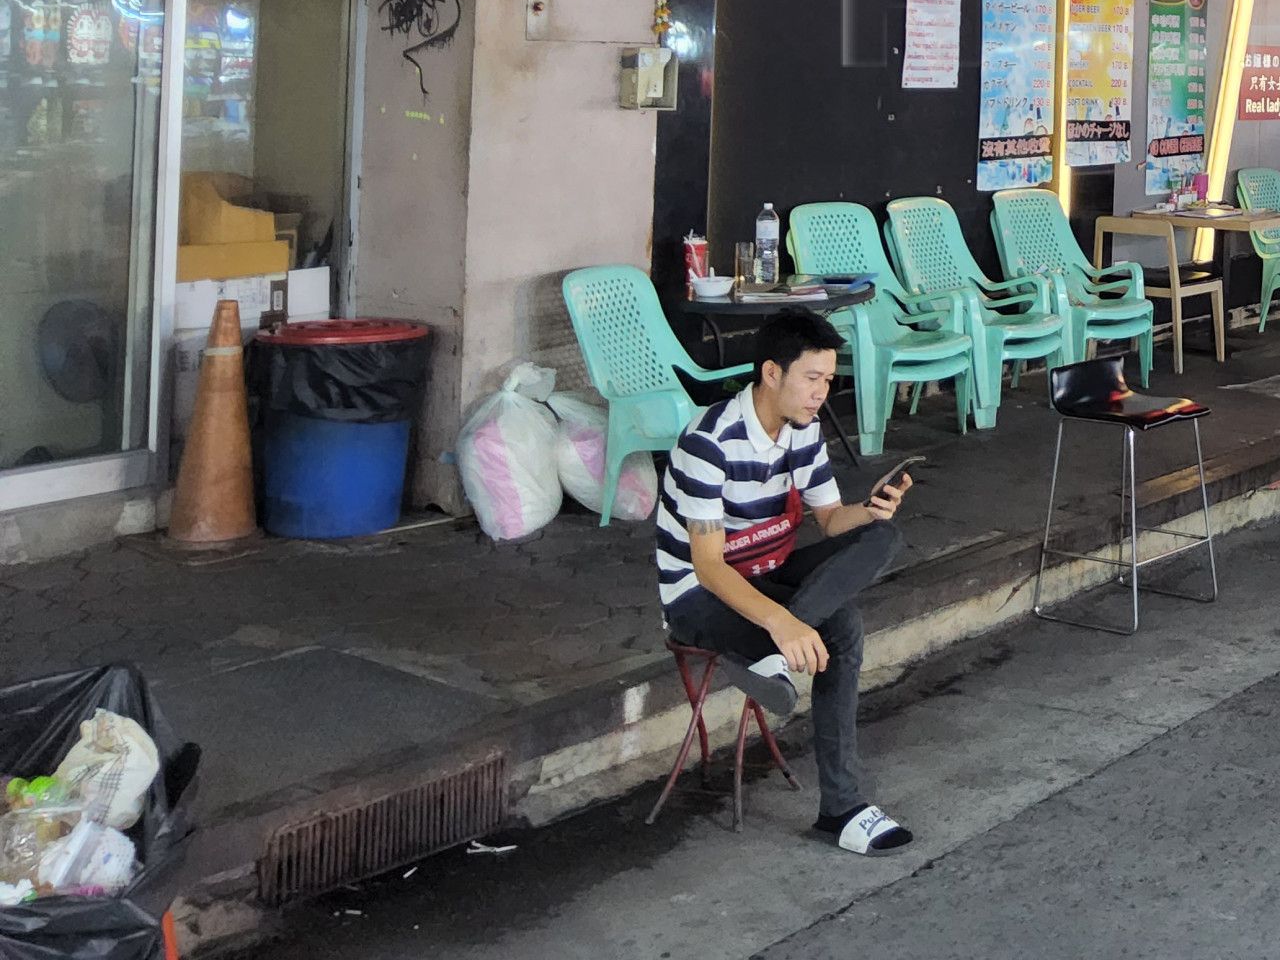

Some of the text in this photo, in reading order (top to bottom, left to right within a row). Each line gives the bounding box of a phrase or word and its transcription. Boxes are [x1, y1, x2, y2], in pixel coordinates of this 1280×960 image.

[1111, 79, 1122, 88] 220
[1246, 97, 1265, 114] Real
[752, 519, 792, 542] ARMOUR
